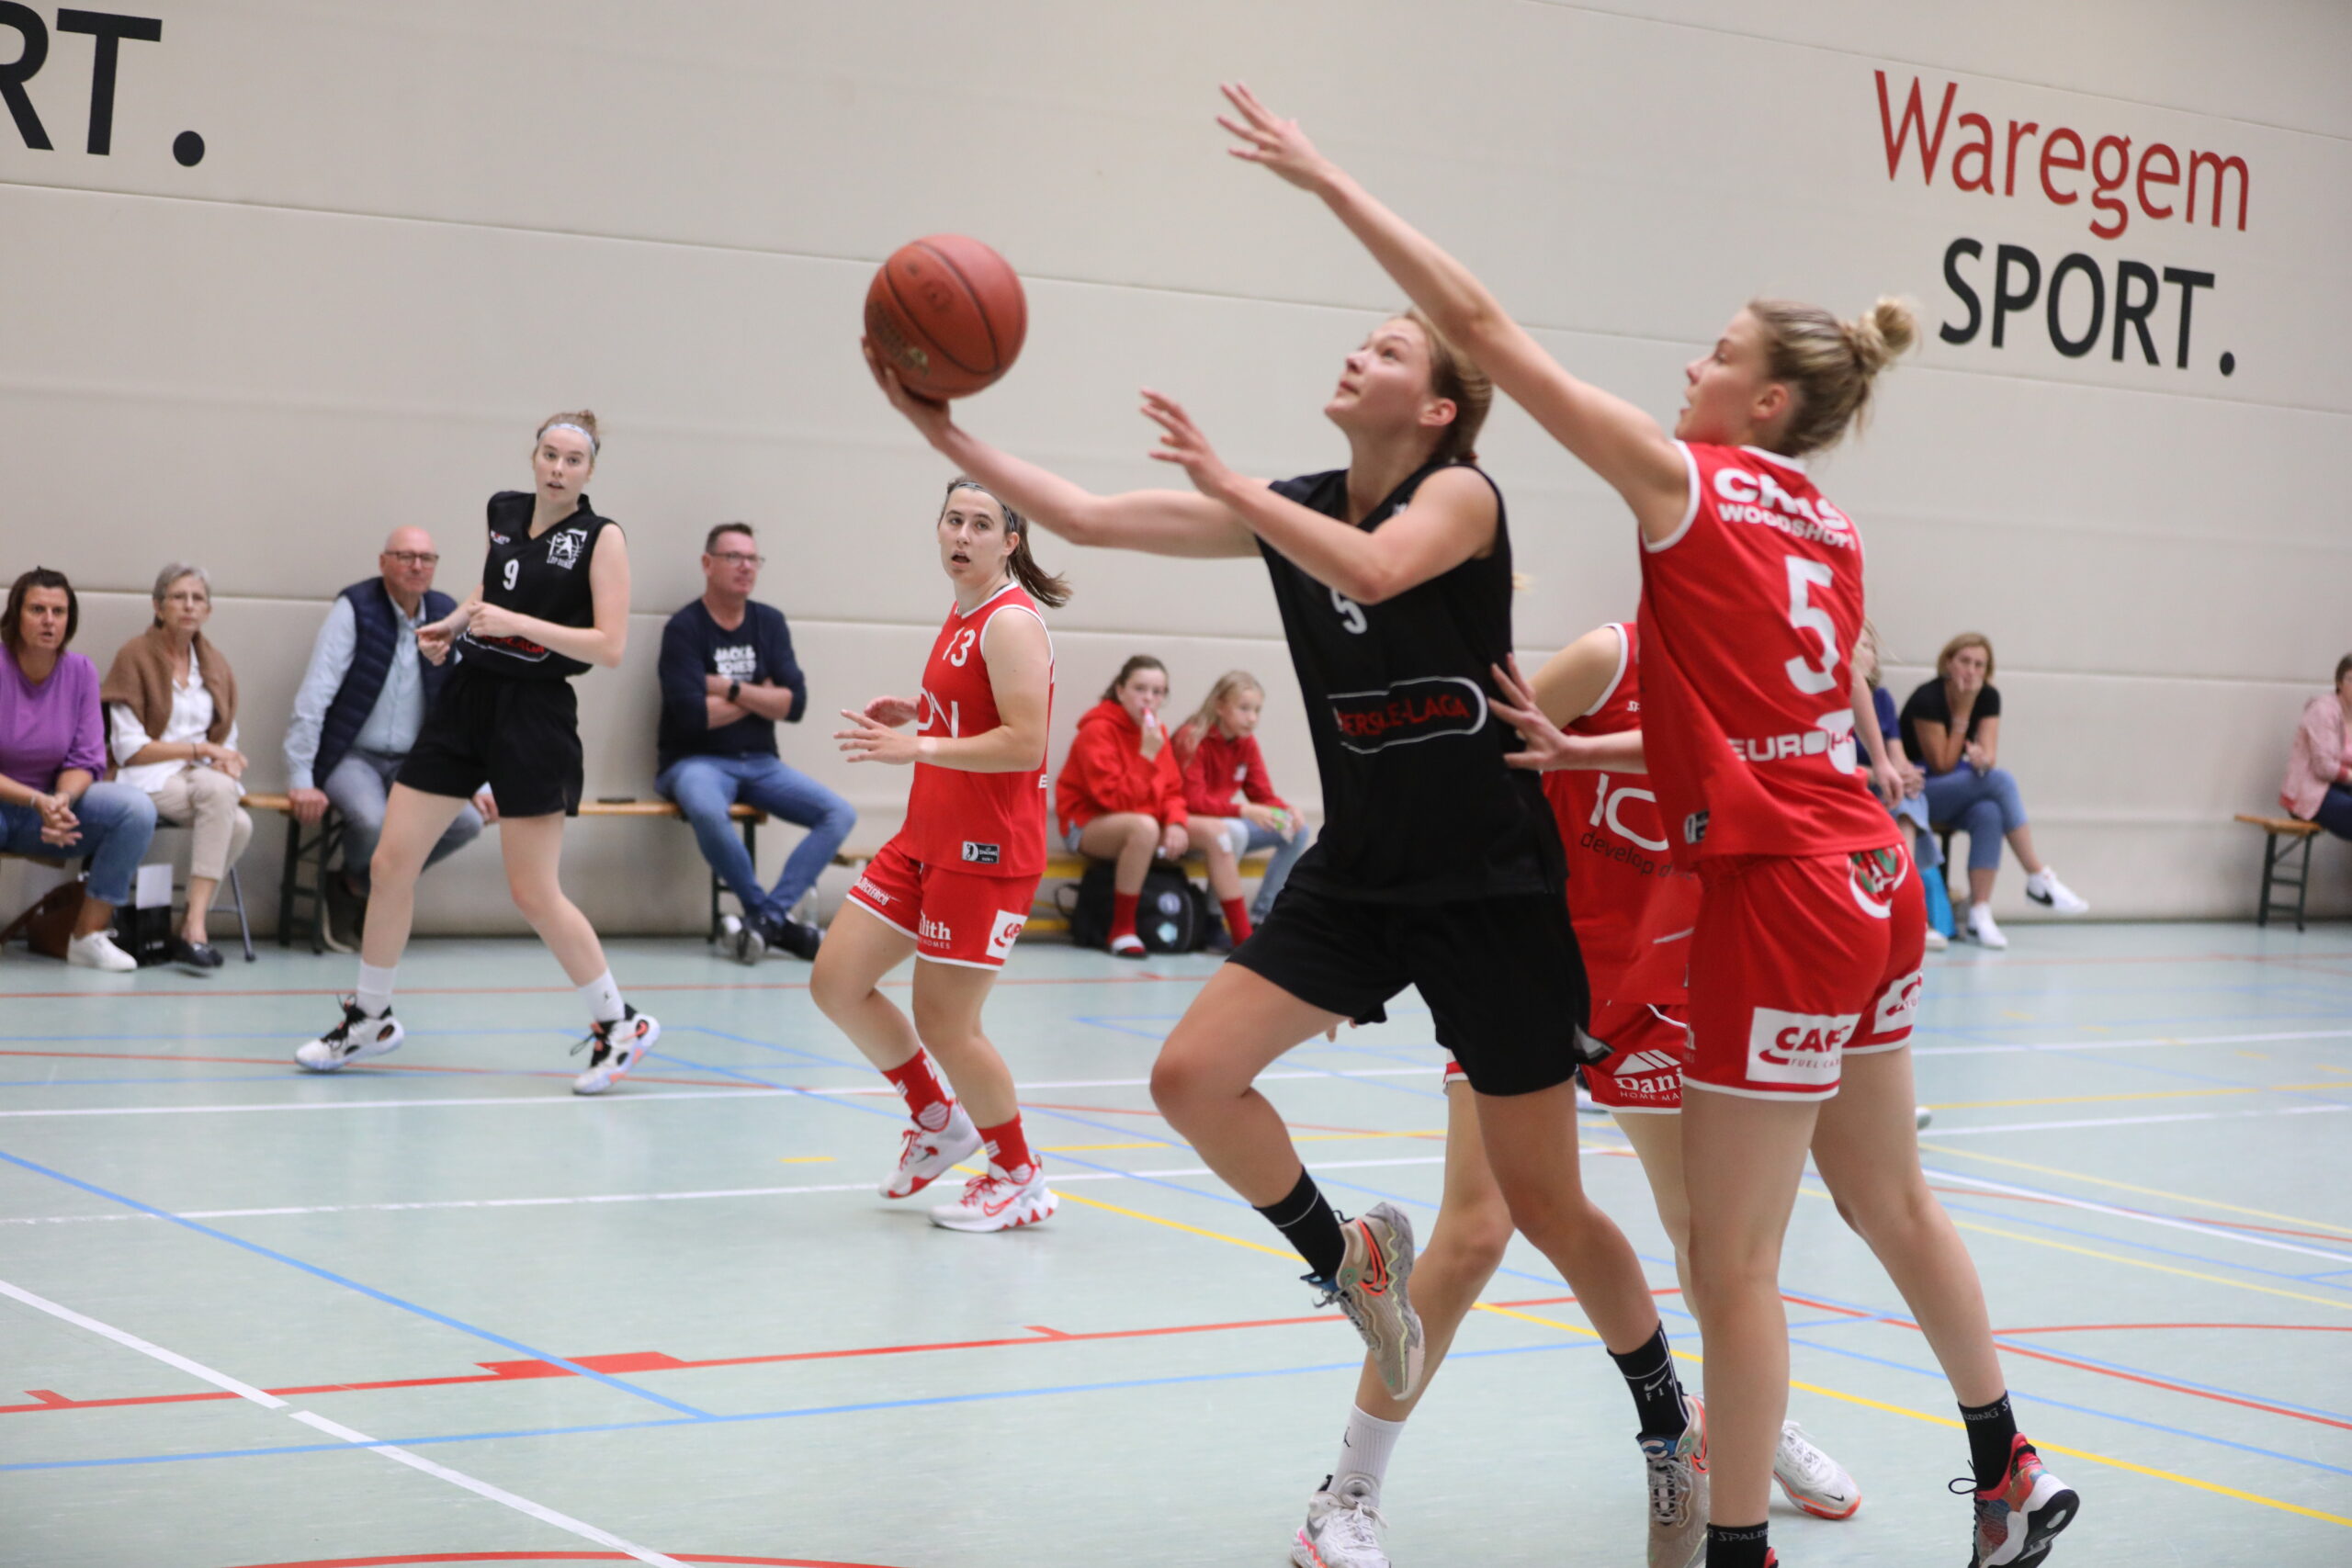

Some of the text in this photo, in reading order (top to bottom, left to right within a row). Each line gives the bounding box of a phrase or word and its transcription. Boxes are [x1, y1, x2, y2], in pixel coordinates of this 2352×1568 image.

[1874, 70, 2250, 240] Waregem
[1939, 237, 2235, 377] SPORT.
[503, 558, 519, 591] 9
[1330, 588, 1367, 634] 5
[1785, 555, 1840, 694] 5
[943, 626, 977, 667] 13
[1580, 831, 1655, 875] develop
[1790, 1058, 1819, 1069] FUEL
[1620, 1091, 1656, 1100] HOME
